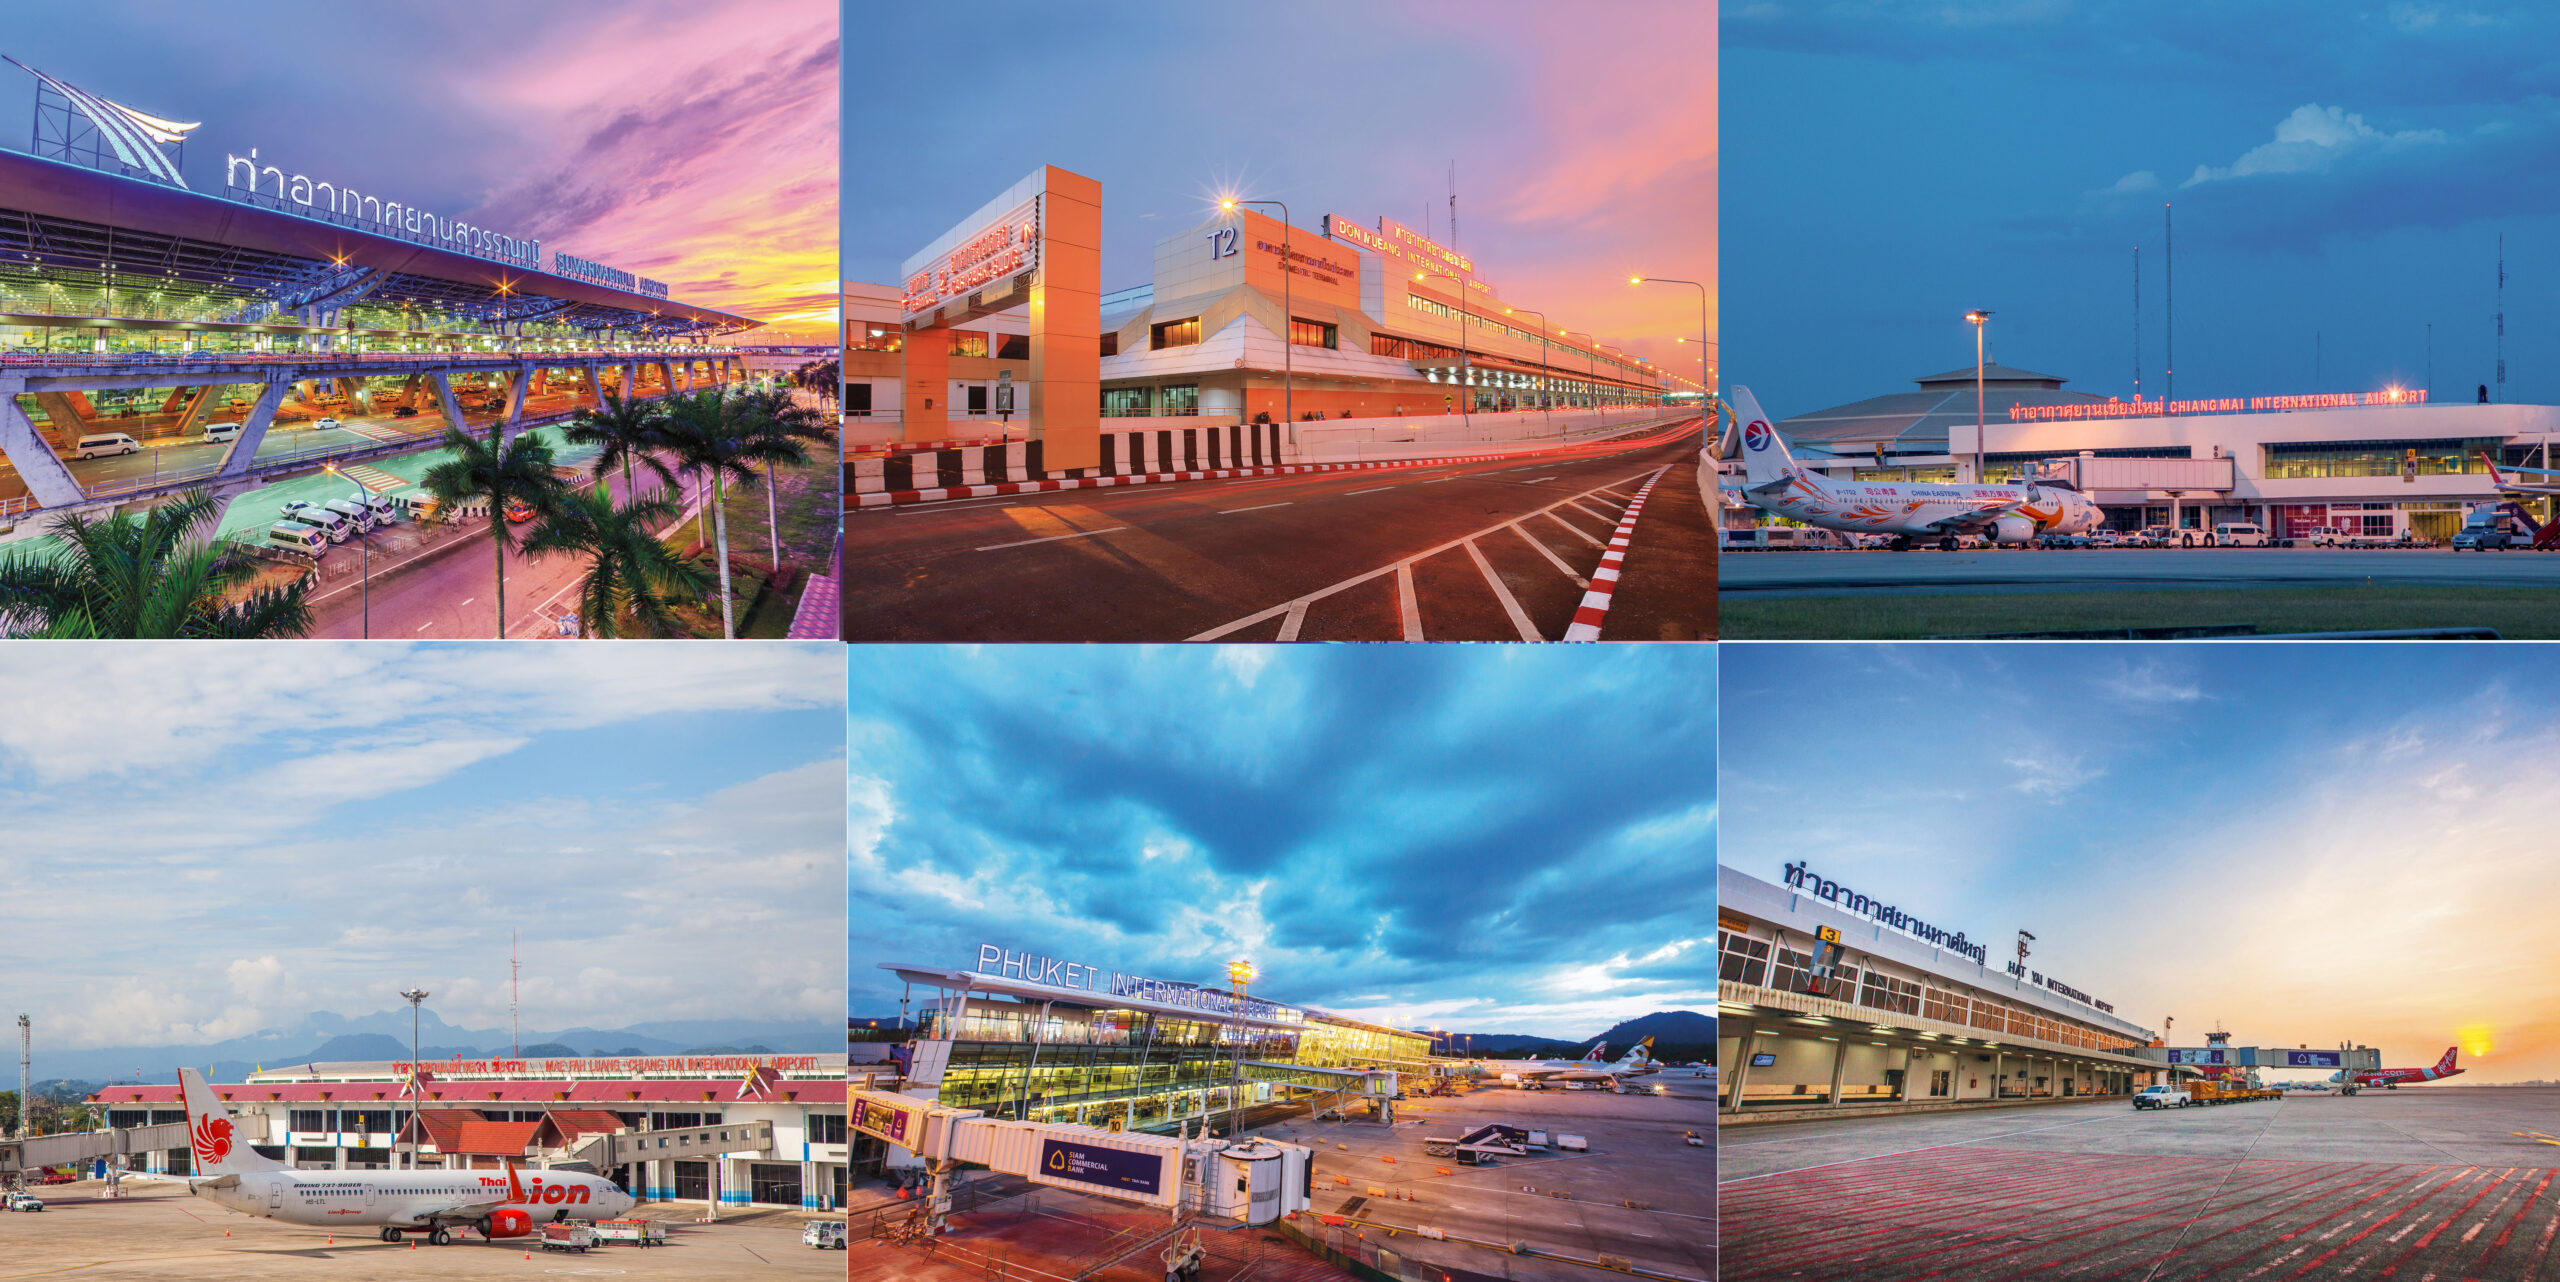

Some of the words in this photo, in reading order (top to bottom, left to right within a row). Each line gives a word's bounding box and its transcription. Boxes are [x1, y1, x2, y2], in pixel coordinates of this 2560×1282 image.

[228, 148, 541, 270] ท่าอากาศยานสุวรรณภูมิ
[1206, 226, 1238, 260] T2
[1339, 220, 1361, 241] DON
[1364, 231, 1401, 257] MUEANG
[1407, 250, 1462, 283] INTERNATIONAL
[1468, 279, 1492, 295] AIRPORT
[2009, 394, 2164, 420] ท่าอากาศยานเชียงใหม่
[2169, 399, 2217, 413] CHIANG
[2219, 398, 2244, 411] MAI
[2251, 394, 2357, 410] INTERNATIONAL
[1784, 861, 1986, 966] ท่าอากาศยานหาดใหญ่
[1825, 929, 1836, 941] 3
[977, 943, 1098, 990] PHUKET
[1110, 971, 1233, 1014] INTERNATIONAL
[2007, 960, 2027, 978] HAT
[2031, 970, 2043, 986] YAI
[2047, 977, 2093, 1006] INTERNATIONAL
[392, 1053, 487, 1074] ท่าอาาศยานแม่ฟ้าหลวง
[545, 1060, 565, 1072] MAE
[568, 1060, 586, 1072] FAH
[589, 1059, 620, 1072] LUANG
[627, 1058, 663, 1072] CHIANG
[667, 1058, 684, 1071] RAI
[688, 1057, 762, 1070] INTERNATIONAL
[769, 1056, 816, 1070] AIRPORT
[1111, 1121, 1121, 1131] 10
[1068, 1158, 1108, 1171] COMMERCIAL
[1069, 1151, 1085, 1160] SIAM
[1067, 1165, 1085, 1174] BANK
[479, 1177, 507, 1187] Thai
